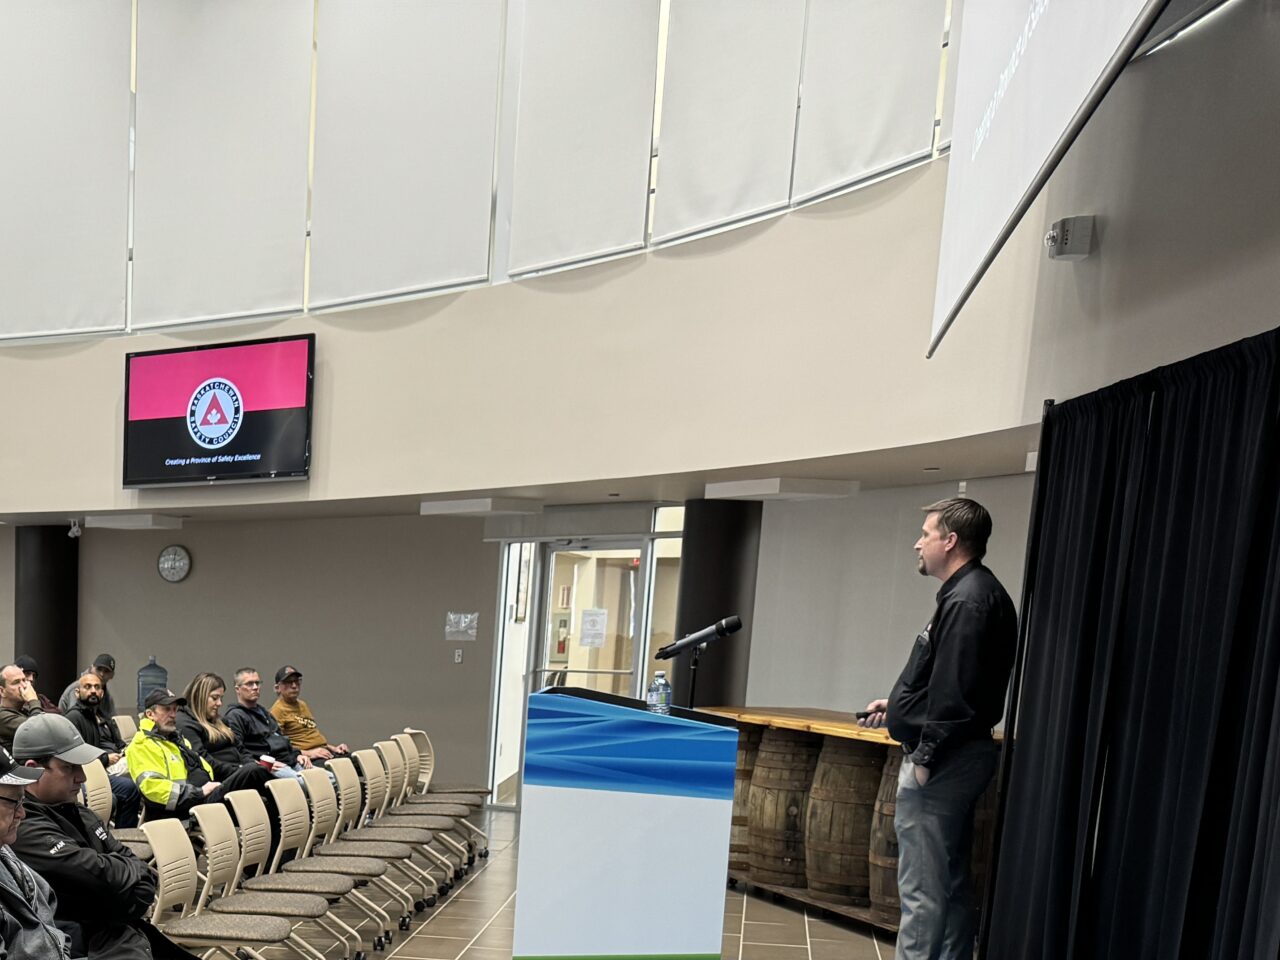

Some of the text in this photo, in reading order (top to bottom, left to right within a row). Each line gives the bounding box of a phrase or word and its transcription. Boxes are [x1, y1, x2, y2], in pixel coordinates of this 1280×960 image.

[191, 382, 239, 411] SASKATCHEWAN
[190, 414, 239, 445] SAFETY COUNCIL
[165, 458, 185, 466] Creating
[218, 455, 234, 463] Safety
[234, 453, 261, 462] Excellence
